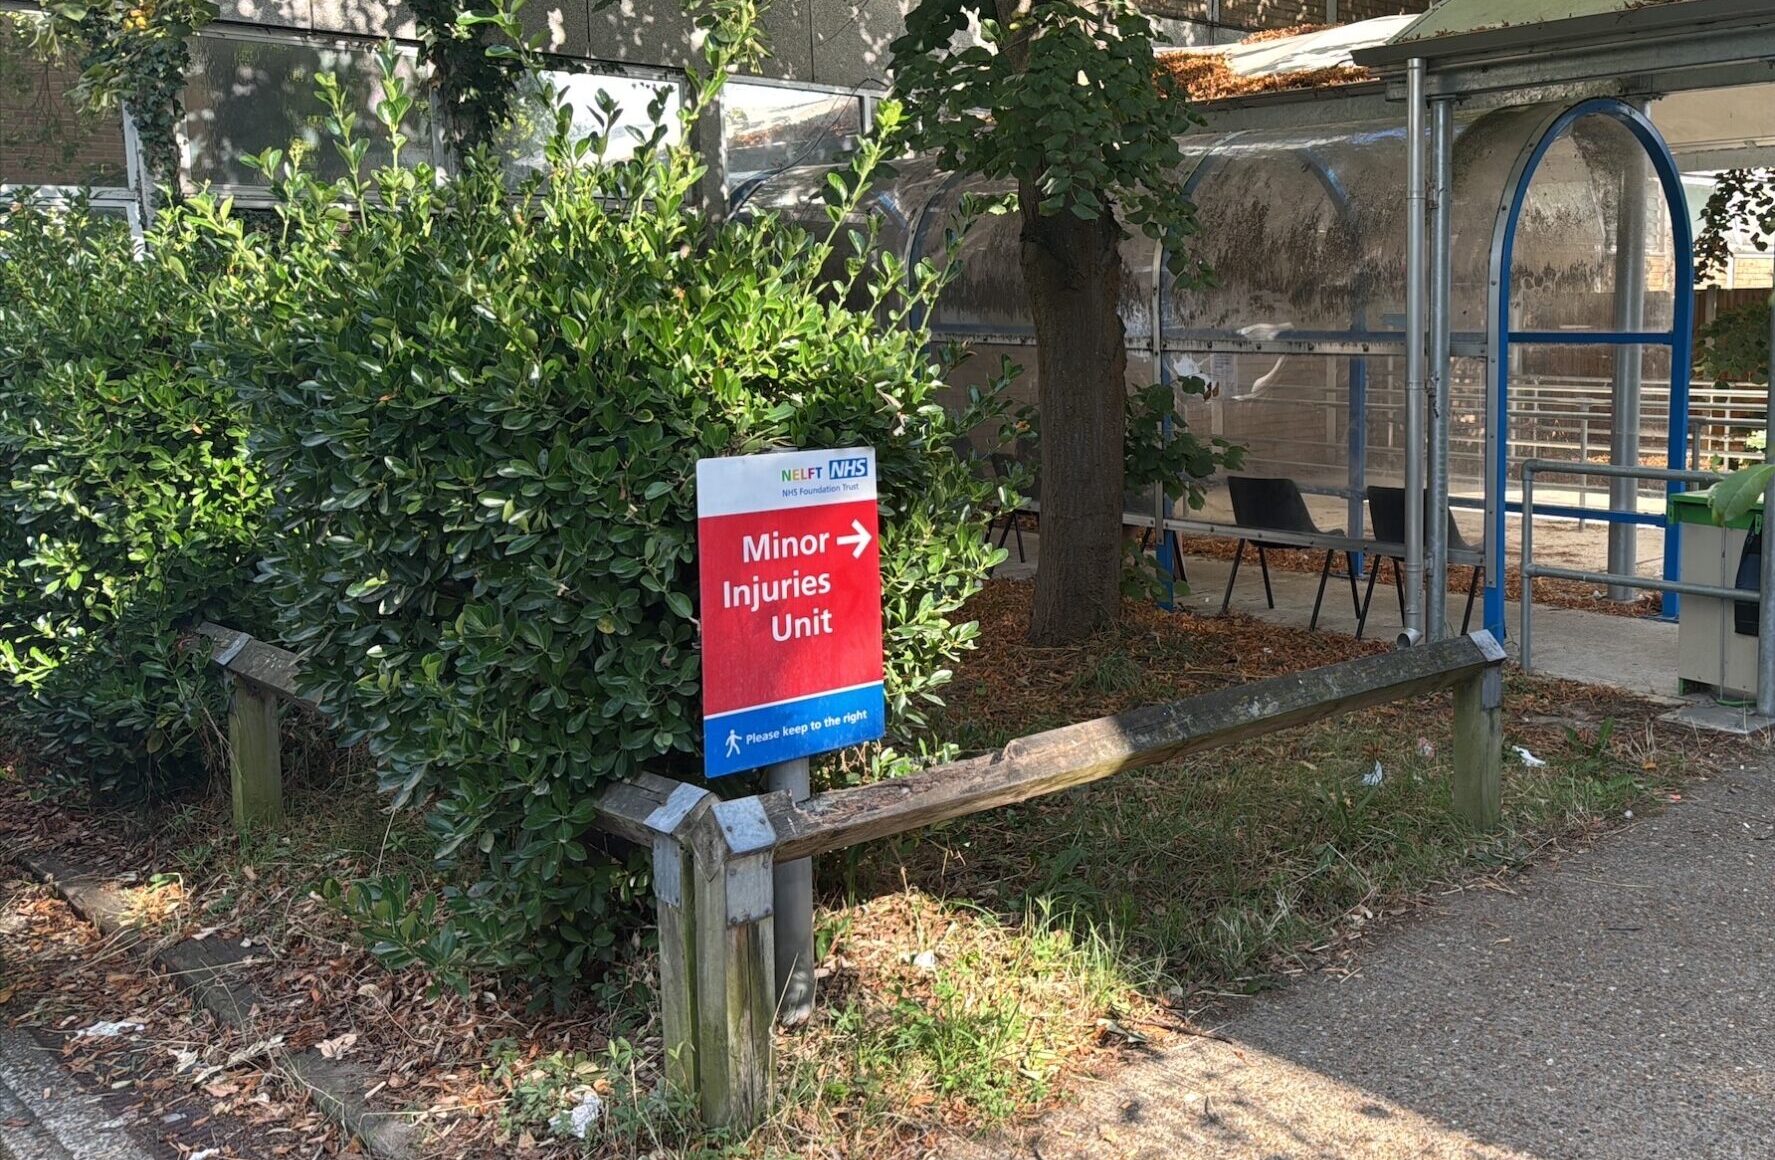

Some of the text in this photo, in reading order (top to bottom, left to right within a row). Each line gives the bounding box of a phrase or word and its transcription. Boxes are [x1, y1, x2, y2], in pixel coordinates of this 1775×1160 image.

[781, 458, 867, 482] NELFT NHS
[782, 482, 859, 498] NHS Foundation Trust
[742, 530, 831, 563] Minor
[723, 569, 832, 613] Injuries
[771, 607, 833, 642] Unit
[746, 709, 868, 745] Please keep to the right
